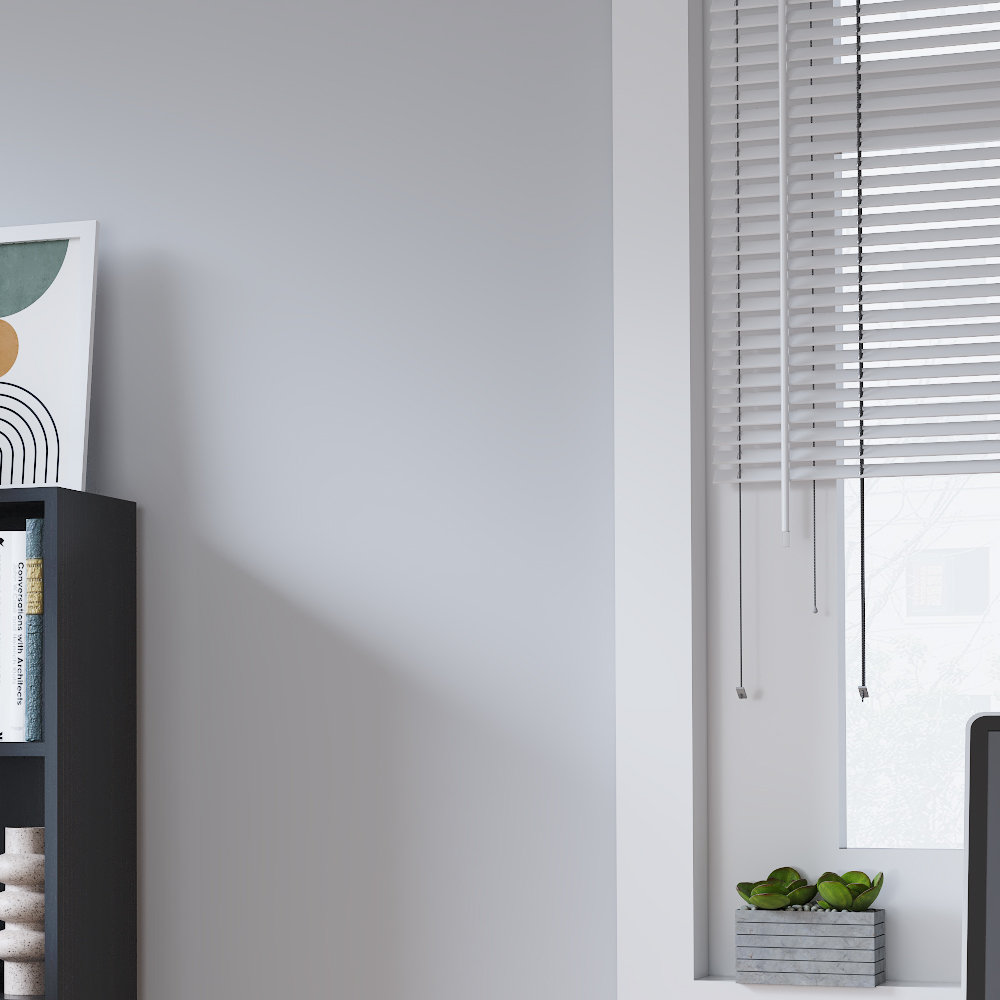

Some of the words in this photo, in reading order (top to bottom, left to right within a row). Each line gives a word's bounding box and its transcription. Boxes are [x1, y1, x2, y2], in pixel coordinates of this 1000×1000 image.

[17, 561, 25, 631] Conversations
[16, 633, 24, 654] with
[16, 656, 24, 707] Architects
